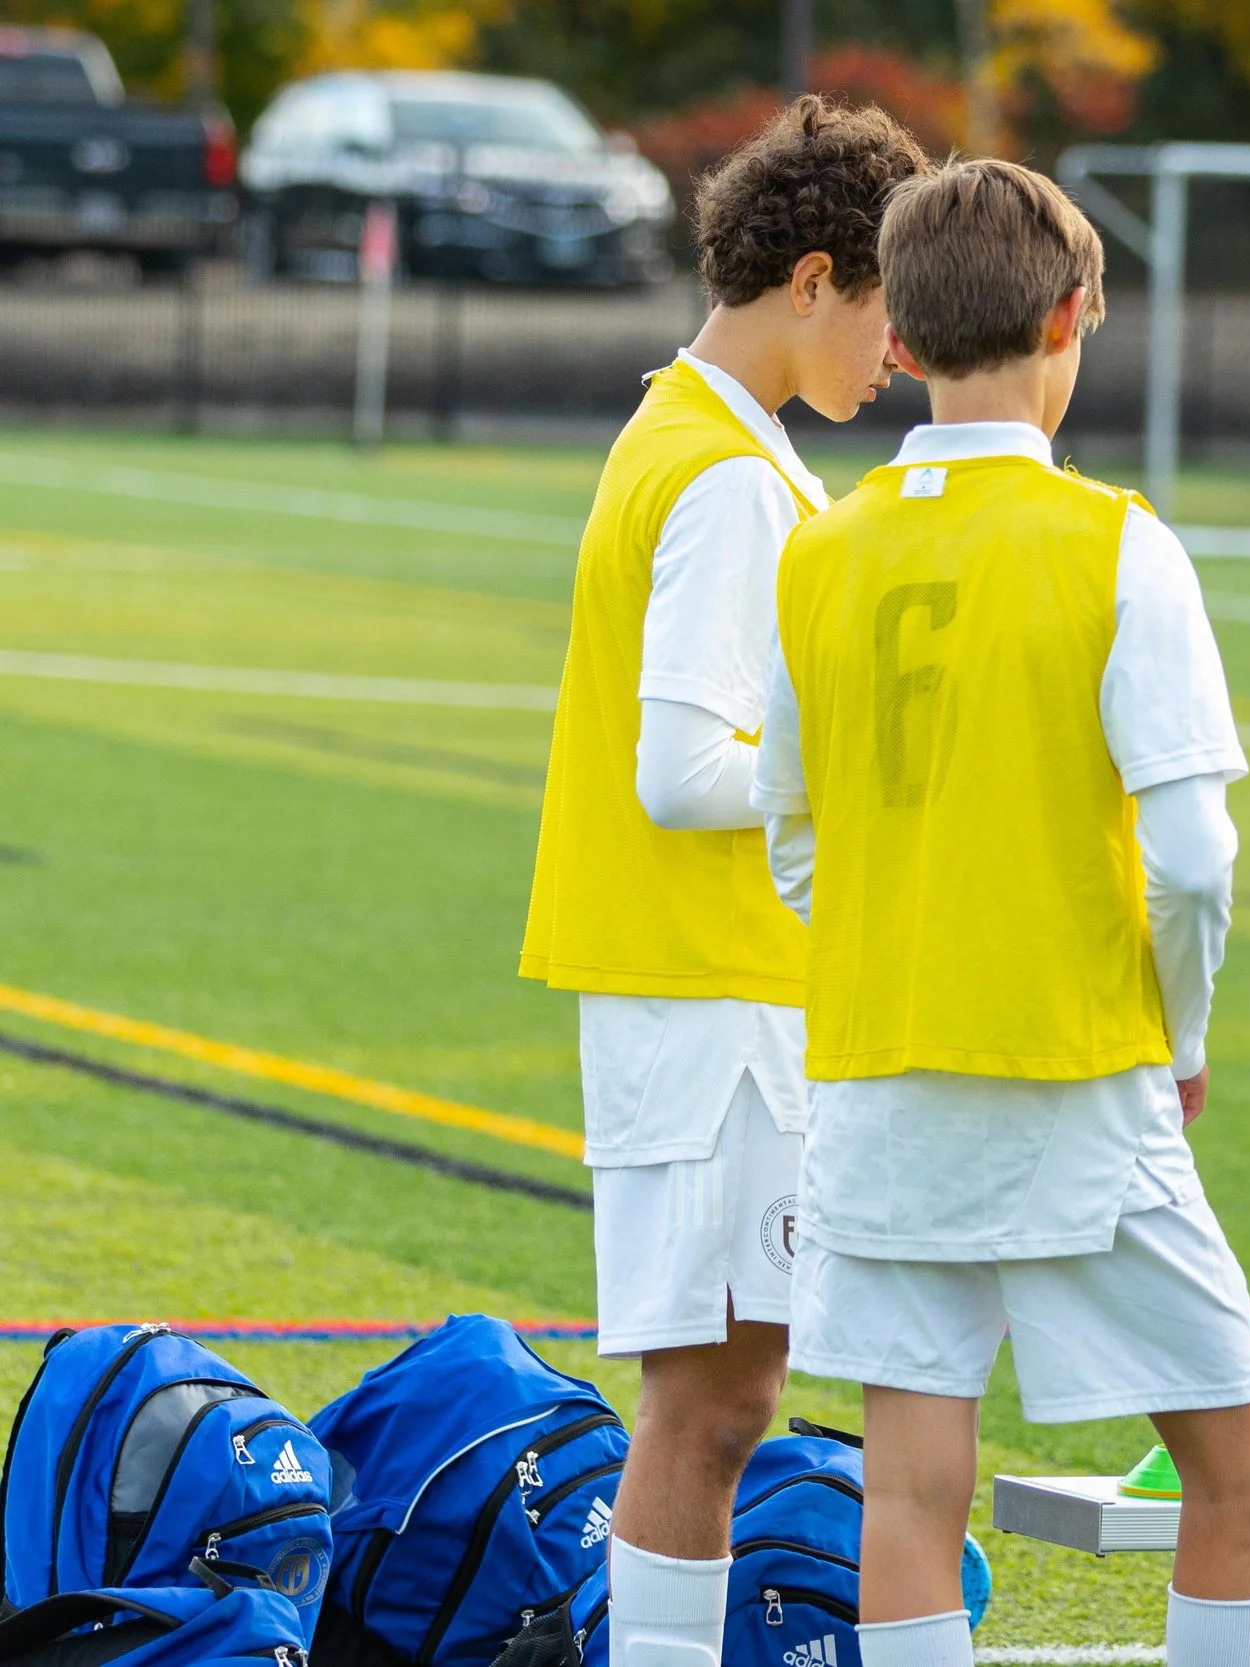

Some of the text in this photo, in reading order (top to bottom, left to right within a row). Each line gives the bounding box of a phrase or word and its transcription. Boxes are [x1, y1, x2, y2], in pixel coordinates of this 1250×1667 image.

[763, 1198, 796, 1263] INTERCONTINENTAL
[271, 1468, 313, 1484] adidas
[580, 1520, 610, 1549] adid
[783, 1651, 825, 1667] adid
